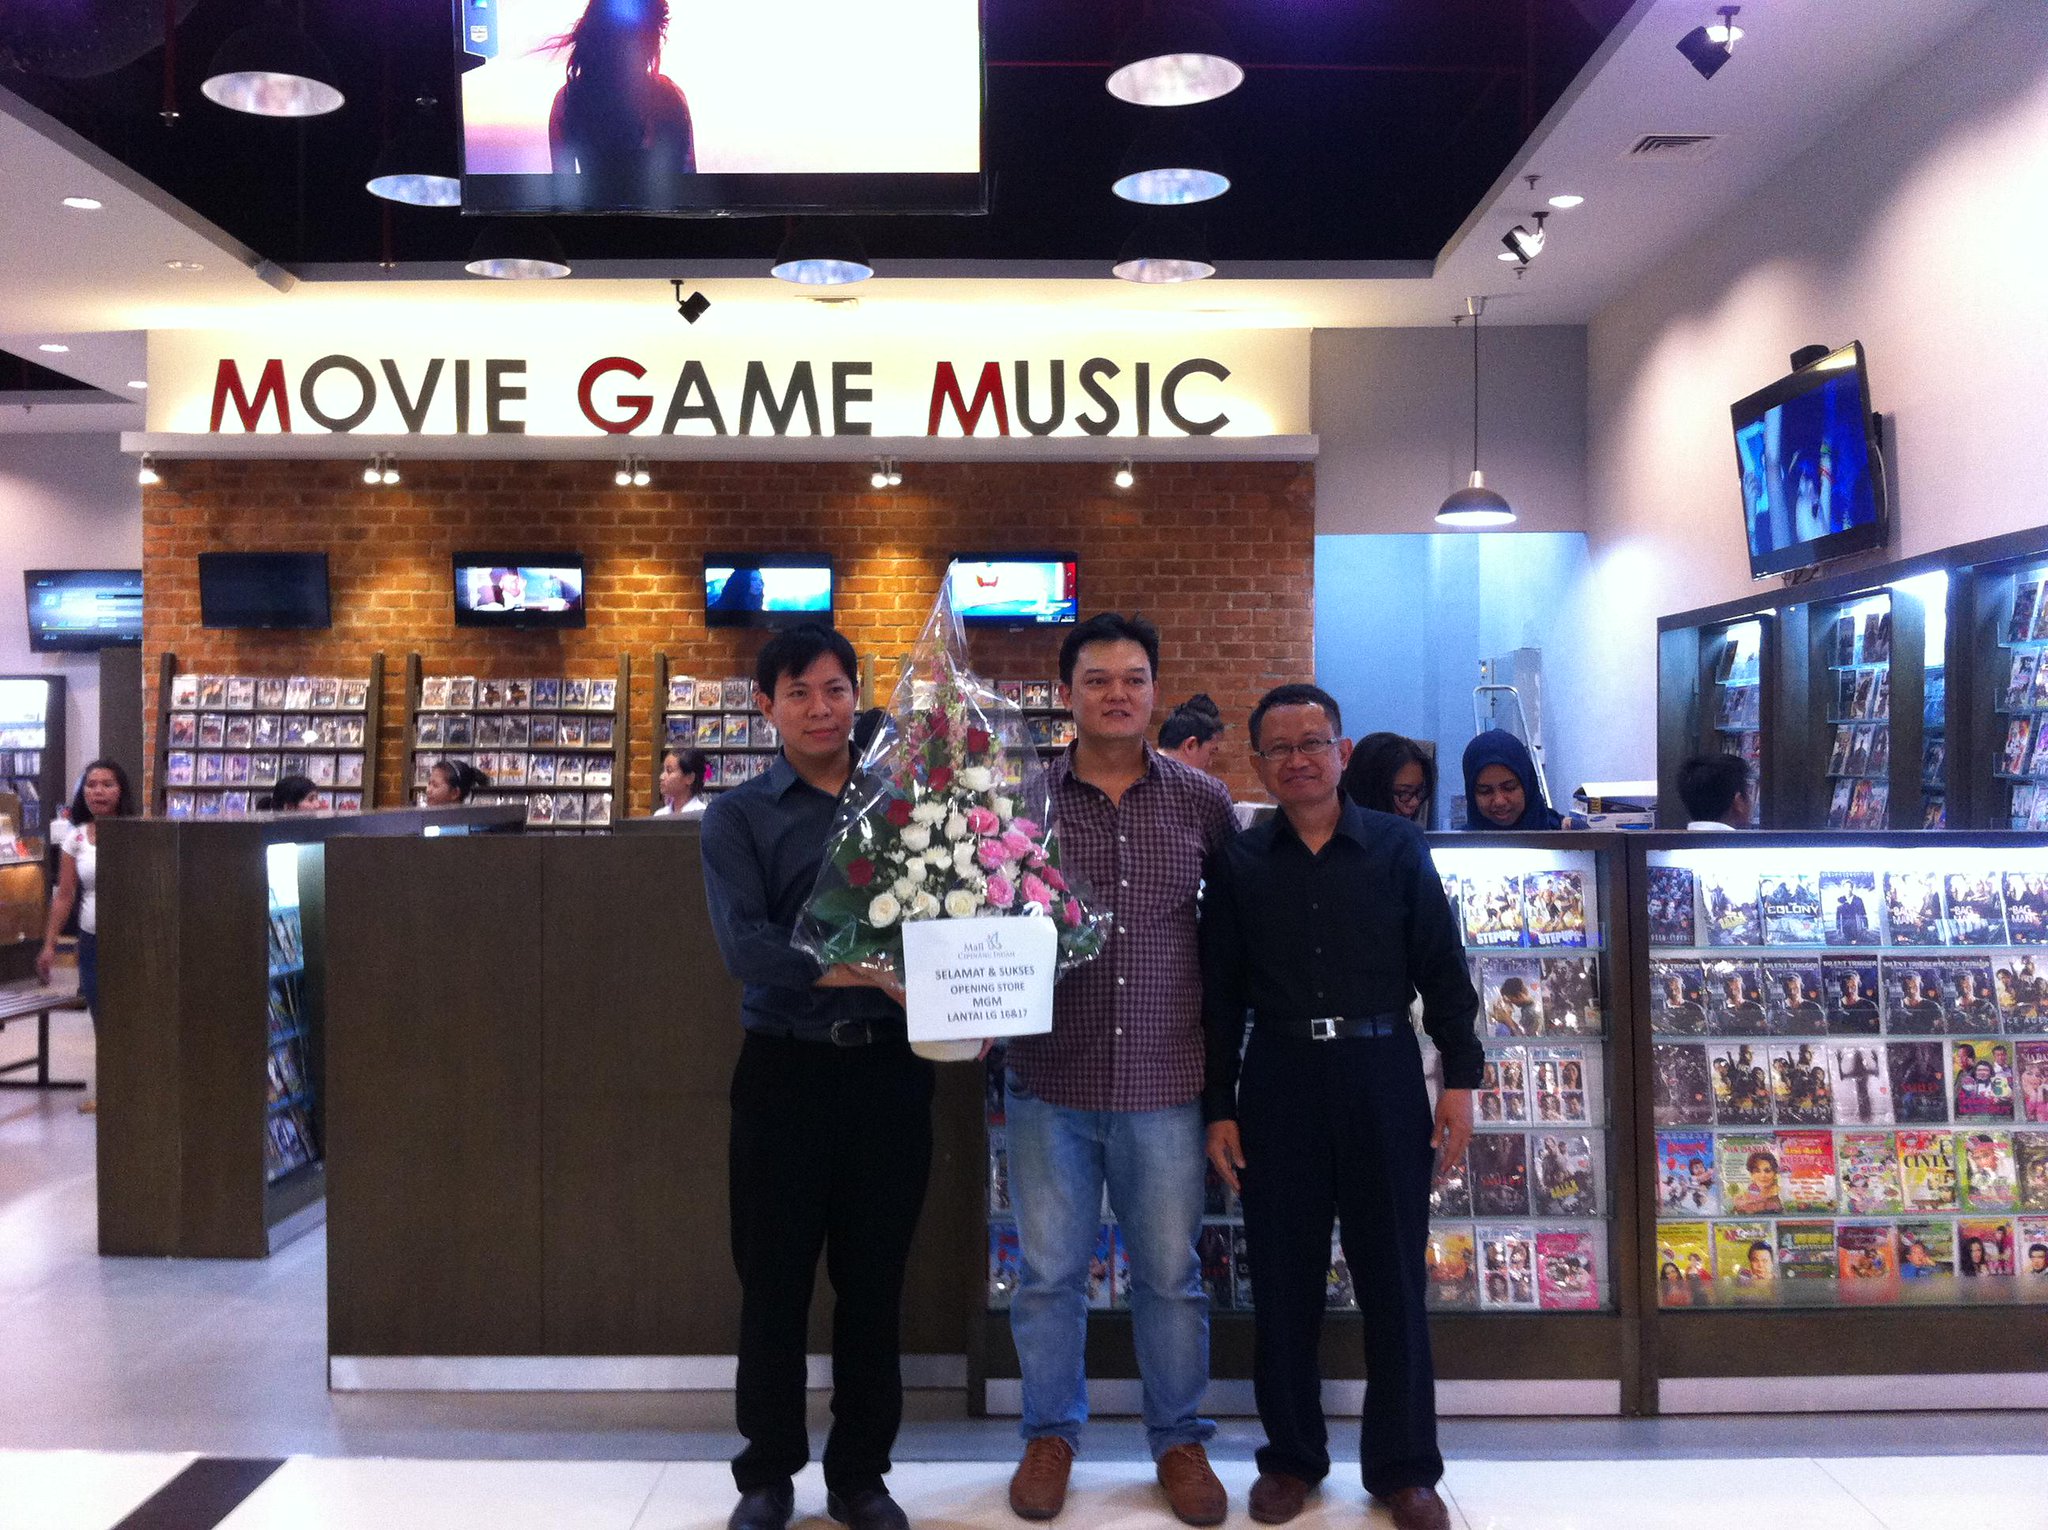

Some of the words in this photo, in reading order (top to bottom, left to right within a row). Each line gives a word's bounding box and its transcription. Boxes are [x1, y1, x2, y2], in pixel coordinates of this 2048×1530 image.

[209, 354, 527, 434] MOVIE
[577, 356, 873, 435] GAME
[926, 357, 1232, 435] MUSIC
[1767, 905, 1819, 915] COLONY
[963, 942, 984, 953] Mall
[935, 969, 984, 981] SELAMAT
[988, 968, 996, 977] &
[999, 965, 1035, 977] SUKSES
[950, 984, 995, 995] OPENING
[997, 982, 1025, 992] STORE
[973, 996, 1002, 1007] MGM
[947, 1012, 983, 1023] LANTAI
[986, 1011, 997, 1020] LG
[1001, 1009, 1028, 1019] 16&17
[1903, 1155, 1949, 1169] CINTA
